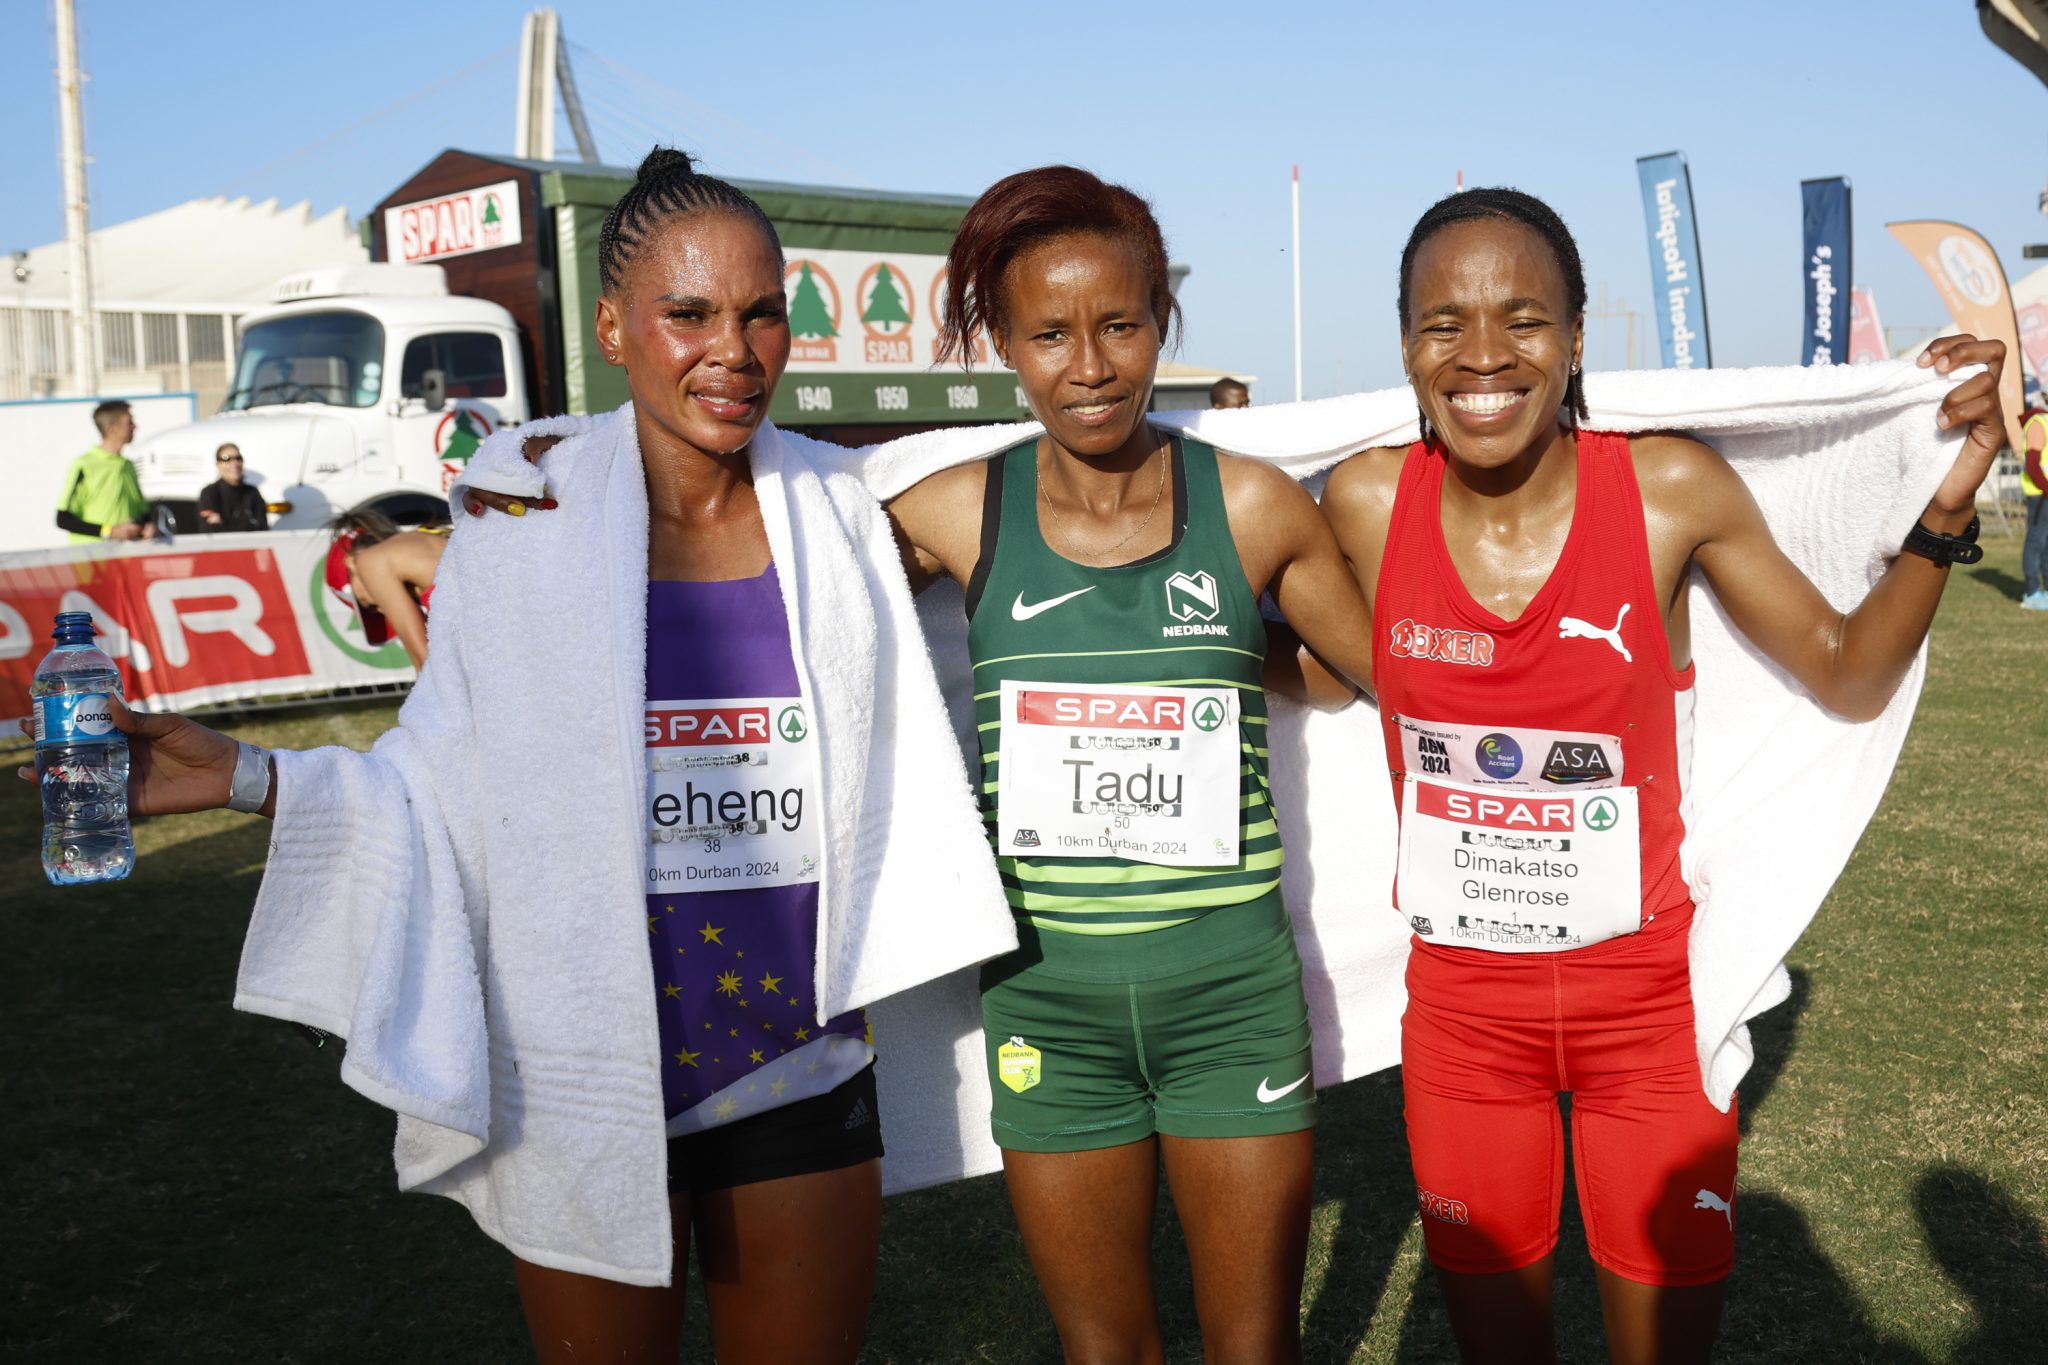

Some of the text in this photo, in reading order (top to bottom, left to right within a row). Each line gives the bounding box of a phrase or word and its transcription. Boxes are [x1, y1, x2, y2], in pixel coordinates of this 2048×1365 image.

[402, 195, 475, 261] SPAR
[1810, 245, 1837, 343] Joseph's
[867, 340, 909, 363] SPAR
[795, 386, 833, 411] 1940
[875, 386, 909, 410] 1950
[946, 385, 979, 409] 1960
[1163, 624, 1229, 637] NEDBANK
[1390, 618, 1494, 666] BOXER
[1055, 697, 1182, 726] SPAR
[645, 712, 768, 742] SPAR
[1454, 733, 1462, 741] by
[1418, 735, 1448, 756] AGN
[1420, 754, 1451, 775] 2024
[1488, 760, 1515, 768] Accident
[1497, 754, 1515, 762] Road
[1550, 747, 1604, 769] ASA
[1062, 759, 1183, 804] Tadu
[652, 781, 803, 832] eheng
[1446, 793, 1572, 828] SPAR
[1114, 816, 1131, 830] 50
[704, 839, 721, 853] 38
[1016, 830, 1038, 840] ASA
[1056, 835, 1188, 855] 10km Durban 2024
[649, 867, 681, 882] 0km
[686, 864, 741, 880] Durban
[745, 861, 780, 877] 2024
[1454, 848, 1579, 879] Dimakatso
[1462, 879, 1570, 907] Glenrose
[1412, 917, 1431, 929] ASA
[1511, 911, 1517, 923] 1
[1449, 925, 1581, 945] 10km Durban 2024
[1002, 1051, 1034, 1059] NEDBANK
[1417, 1185, 1469, 1226] OXER
